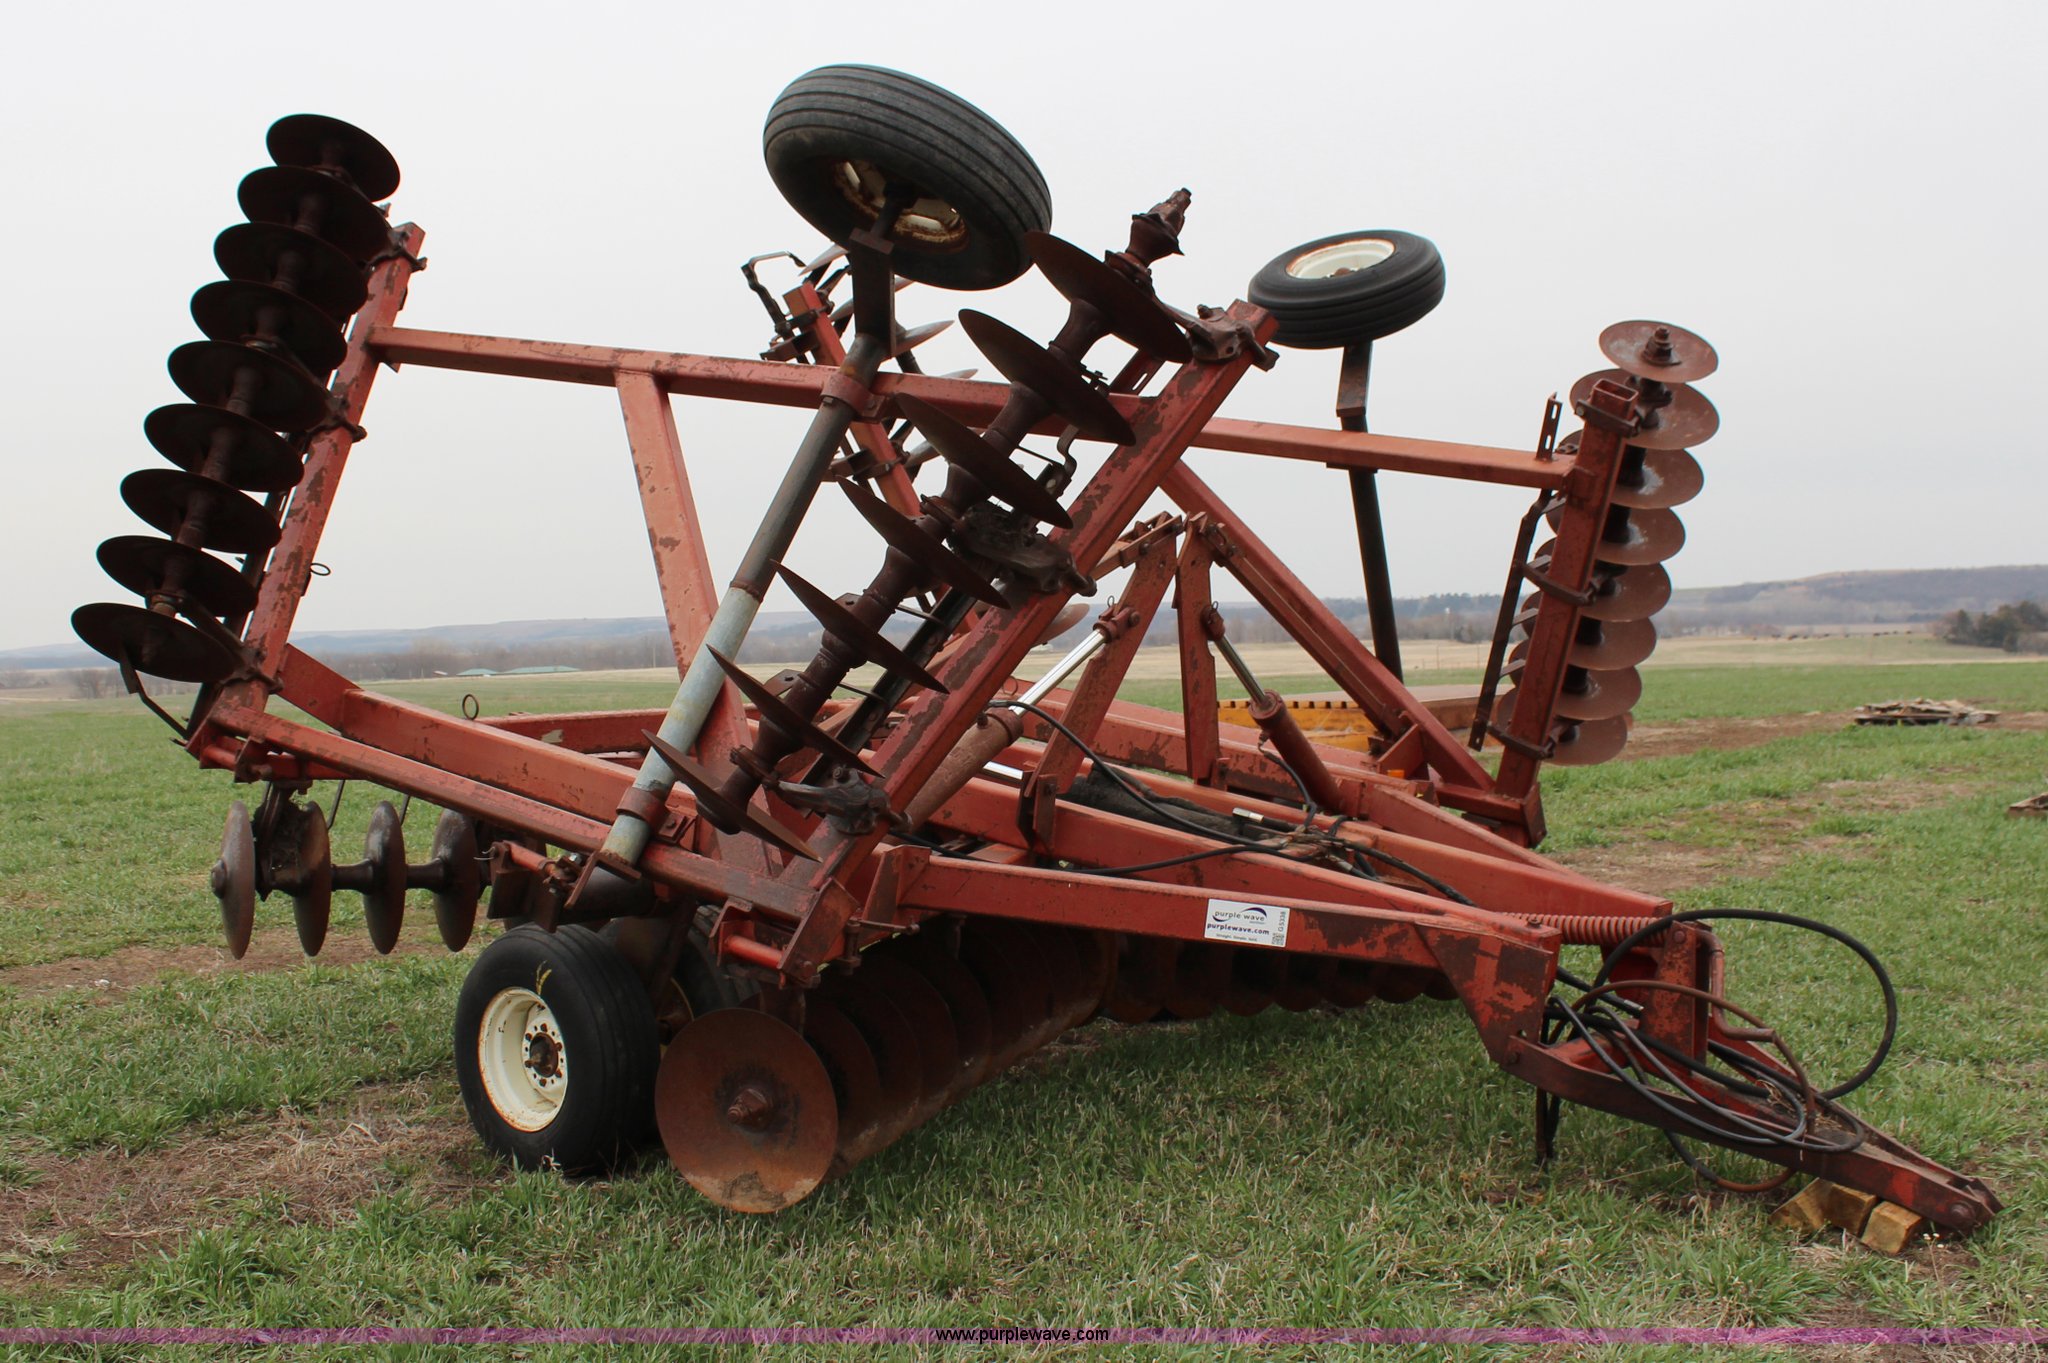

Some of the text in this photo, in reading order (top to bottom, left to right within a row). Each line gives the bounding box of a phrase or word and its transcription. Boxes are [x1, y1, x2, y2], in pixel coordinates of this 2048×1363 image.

[1214, 910, 1265, 922] purple wave
[1207, 922, 1270, 935] purplewave.com
